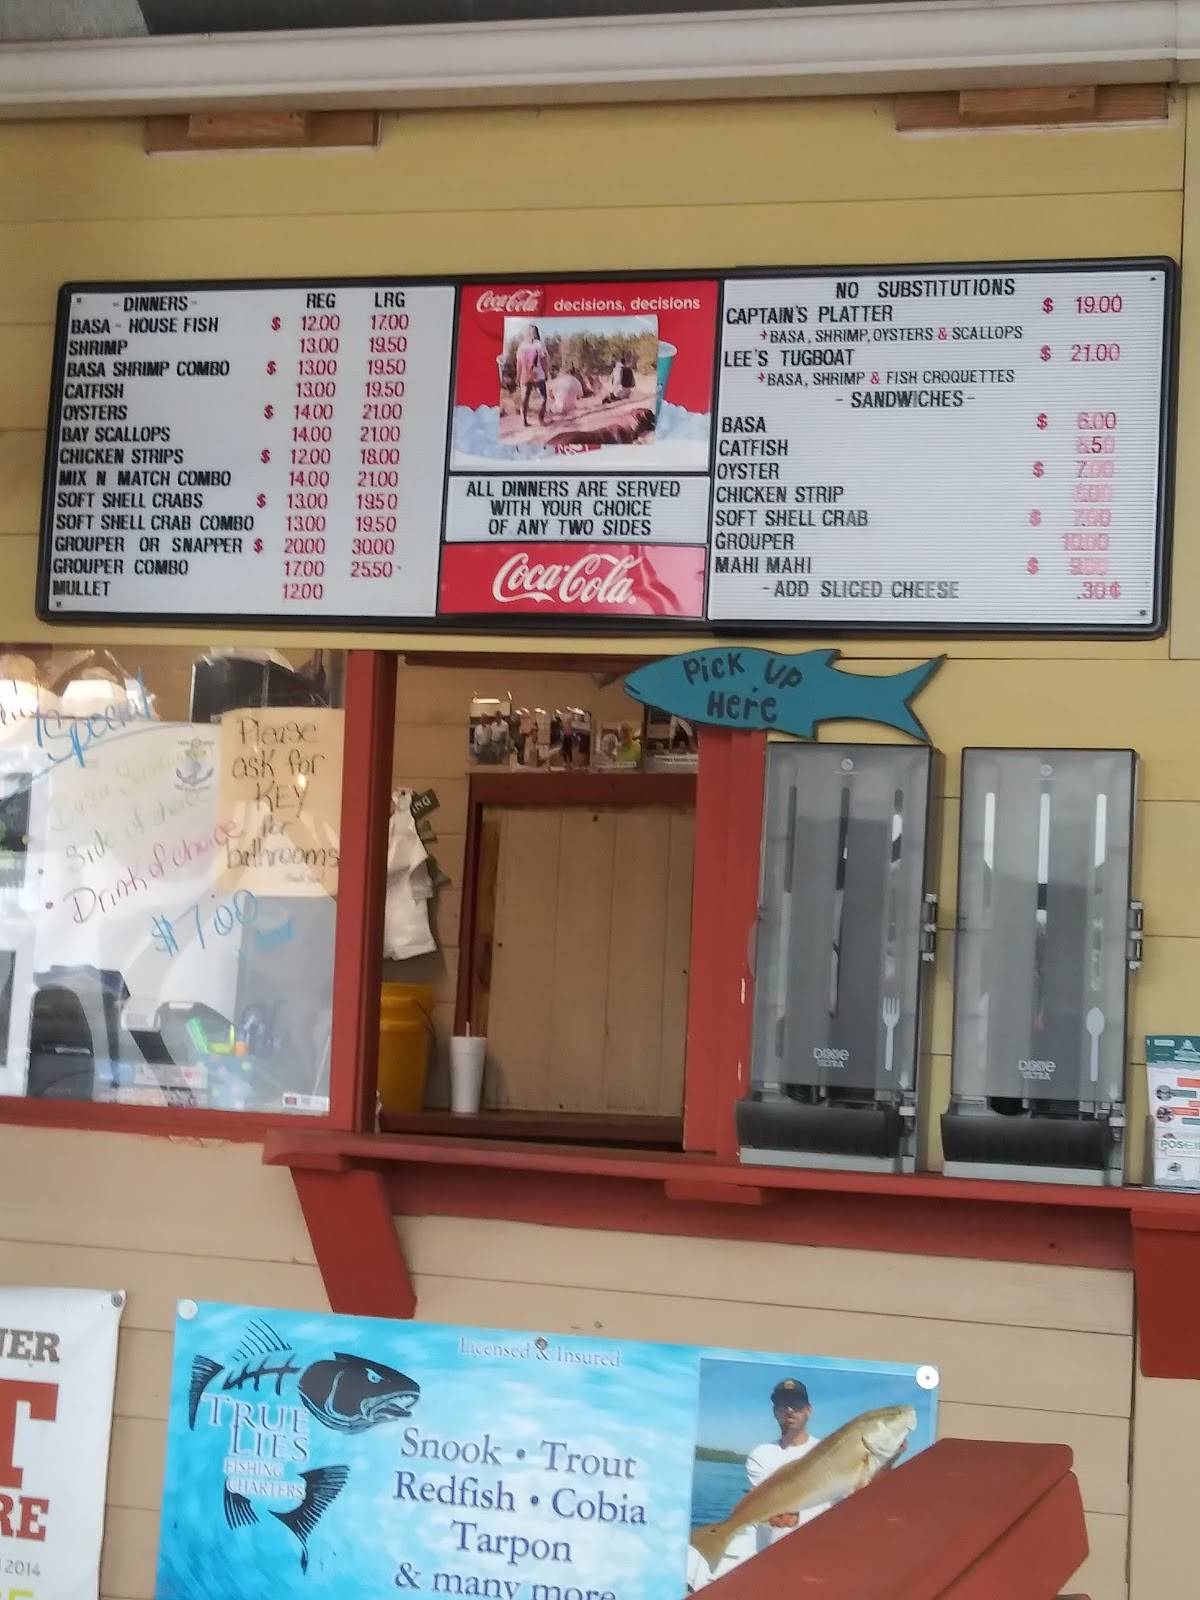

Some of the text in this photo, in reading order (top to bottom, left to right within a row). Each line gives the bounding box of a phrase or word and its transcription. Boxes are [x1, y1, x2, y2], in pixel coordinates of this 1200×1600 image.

[836, 278, 1015, 299] NO SUBSTITUTIONS
[306, 293, 336, 309] REG
[374, 291, 405, 308] LRG
[554, 297, 626, 312] decisions,
[630, 296, 700, 310] decisions
[726, 294, 1122, 325] CAPTAIN'S PLATTER $ 19.00
[71, 313, 409, 335] BASA HOUSE FISH 12.00 17.00
[770, 330, 811, 344] BASA,
[873, 328, 933, 341] OYSTERS
[937, 327, 947, 341] &
[952, 326, 1023, 340] SCALLOPS
[68, 336, 407, 356] SHRIMP 13.00 19.50
[724, 343, 1121, 367] LEE'S TUGBOAT $ 21.00
[67, 359, 406, 378] BASA SHRIMP COMBO 13.00 19.50
[767, 369, 1015, 387] BASA, SHRIMP & FISH CROQUETTES
[64, 381, 405, 399] CATFISH 13.00 19.50
[63, 403, 403, 421] OYSTERS 14.00 21.00
[721, 416, 767, 433] BASA
[1036, 412, 1048, 430] $
[61, 426, 400, 443] BAY SCALLOPS 14.00 21.00
[60, 448, 400, 465] CHICKEN STRIPS 12.00 18.00
[718, 439, 789, 457] CATFISH
[59, 470, 398, 487] MIX N MATCH COMBO 14.00 21.00
[717, 460, 1044, 480] OYSTER $
[466, 480, 681, 497] ALL DINNERS ARE SERVED
[716, 486, 844, 503] CHICKEN STRIP
[57, 492, 95, 508] SOFT
[102, 493, 146, 508] SHELL
[152, 493, 203, 508] CRABS
[287, 493, 328, 509] 13.00
[490, 500, 652, 516] WITH YOUR CHOICE
[56, 514, 397, 532] SOFT SHELL CRAB COMBO 13.00 19.50
[488, 519, 651, 536] OF ANY TWO SIDES
[715, 509, 869, 527] SOFT SHELL CRAB
[55, 536, 124, 552] GROUPER
[139, 536, 160, 552] OR
[172, 537, 243, 553] SNAPPER
[715, 532, 795, 550] GROUPER
[53, 558, 124, 574] GROUPER
[134, 559, 189, 575] COMBO
[283, 560, 325, 577] 17.00
[714, 556, 812, 574] MAHI MAHI
[52, 580, 323, 600] MULLET 12.00
[820, 581, 883, 598] SLICED
[891, 581, 960, 598] CHEESE
[237, 717, 319, 745] Please
[288, 748, 326, 777] for
[256, 780, 309, 817] KEY
[62, 866, 149, 924] Drink
[459, 1337, 621, 1367] Licensed & Insured
[200, 1393, 309, 1433] TRUE
[230, 1425, 309, 1461] LIES
[400, 1427, 637, 1480] Snook Trout
[225, 1458, 283, 1478] FISHING
[226, 1478, 306, 1498] CHARTERS
[393, 1470, 648, 1526] Redfish Cobia
[451, 1520, 573, 1566] Tarpon
[394, 1561, 421, 1590] &
[432, 1569, 521, 1600] many
